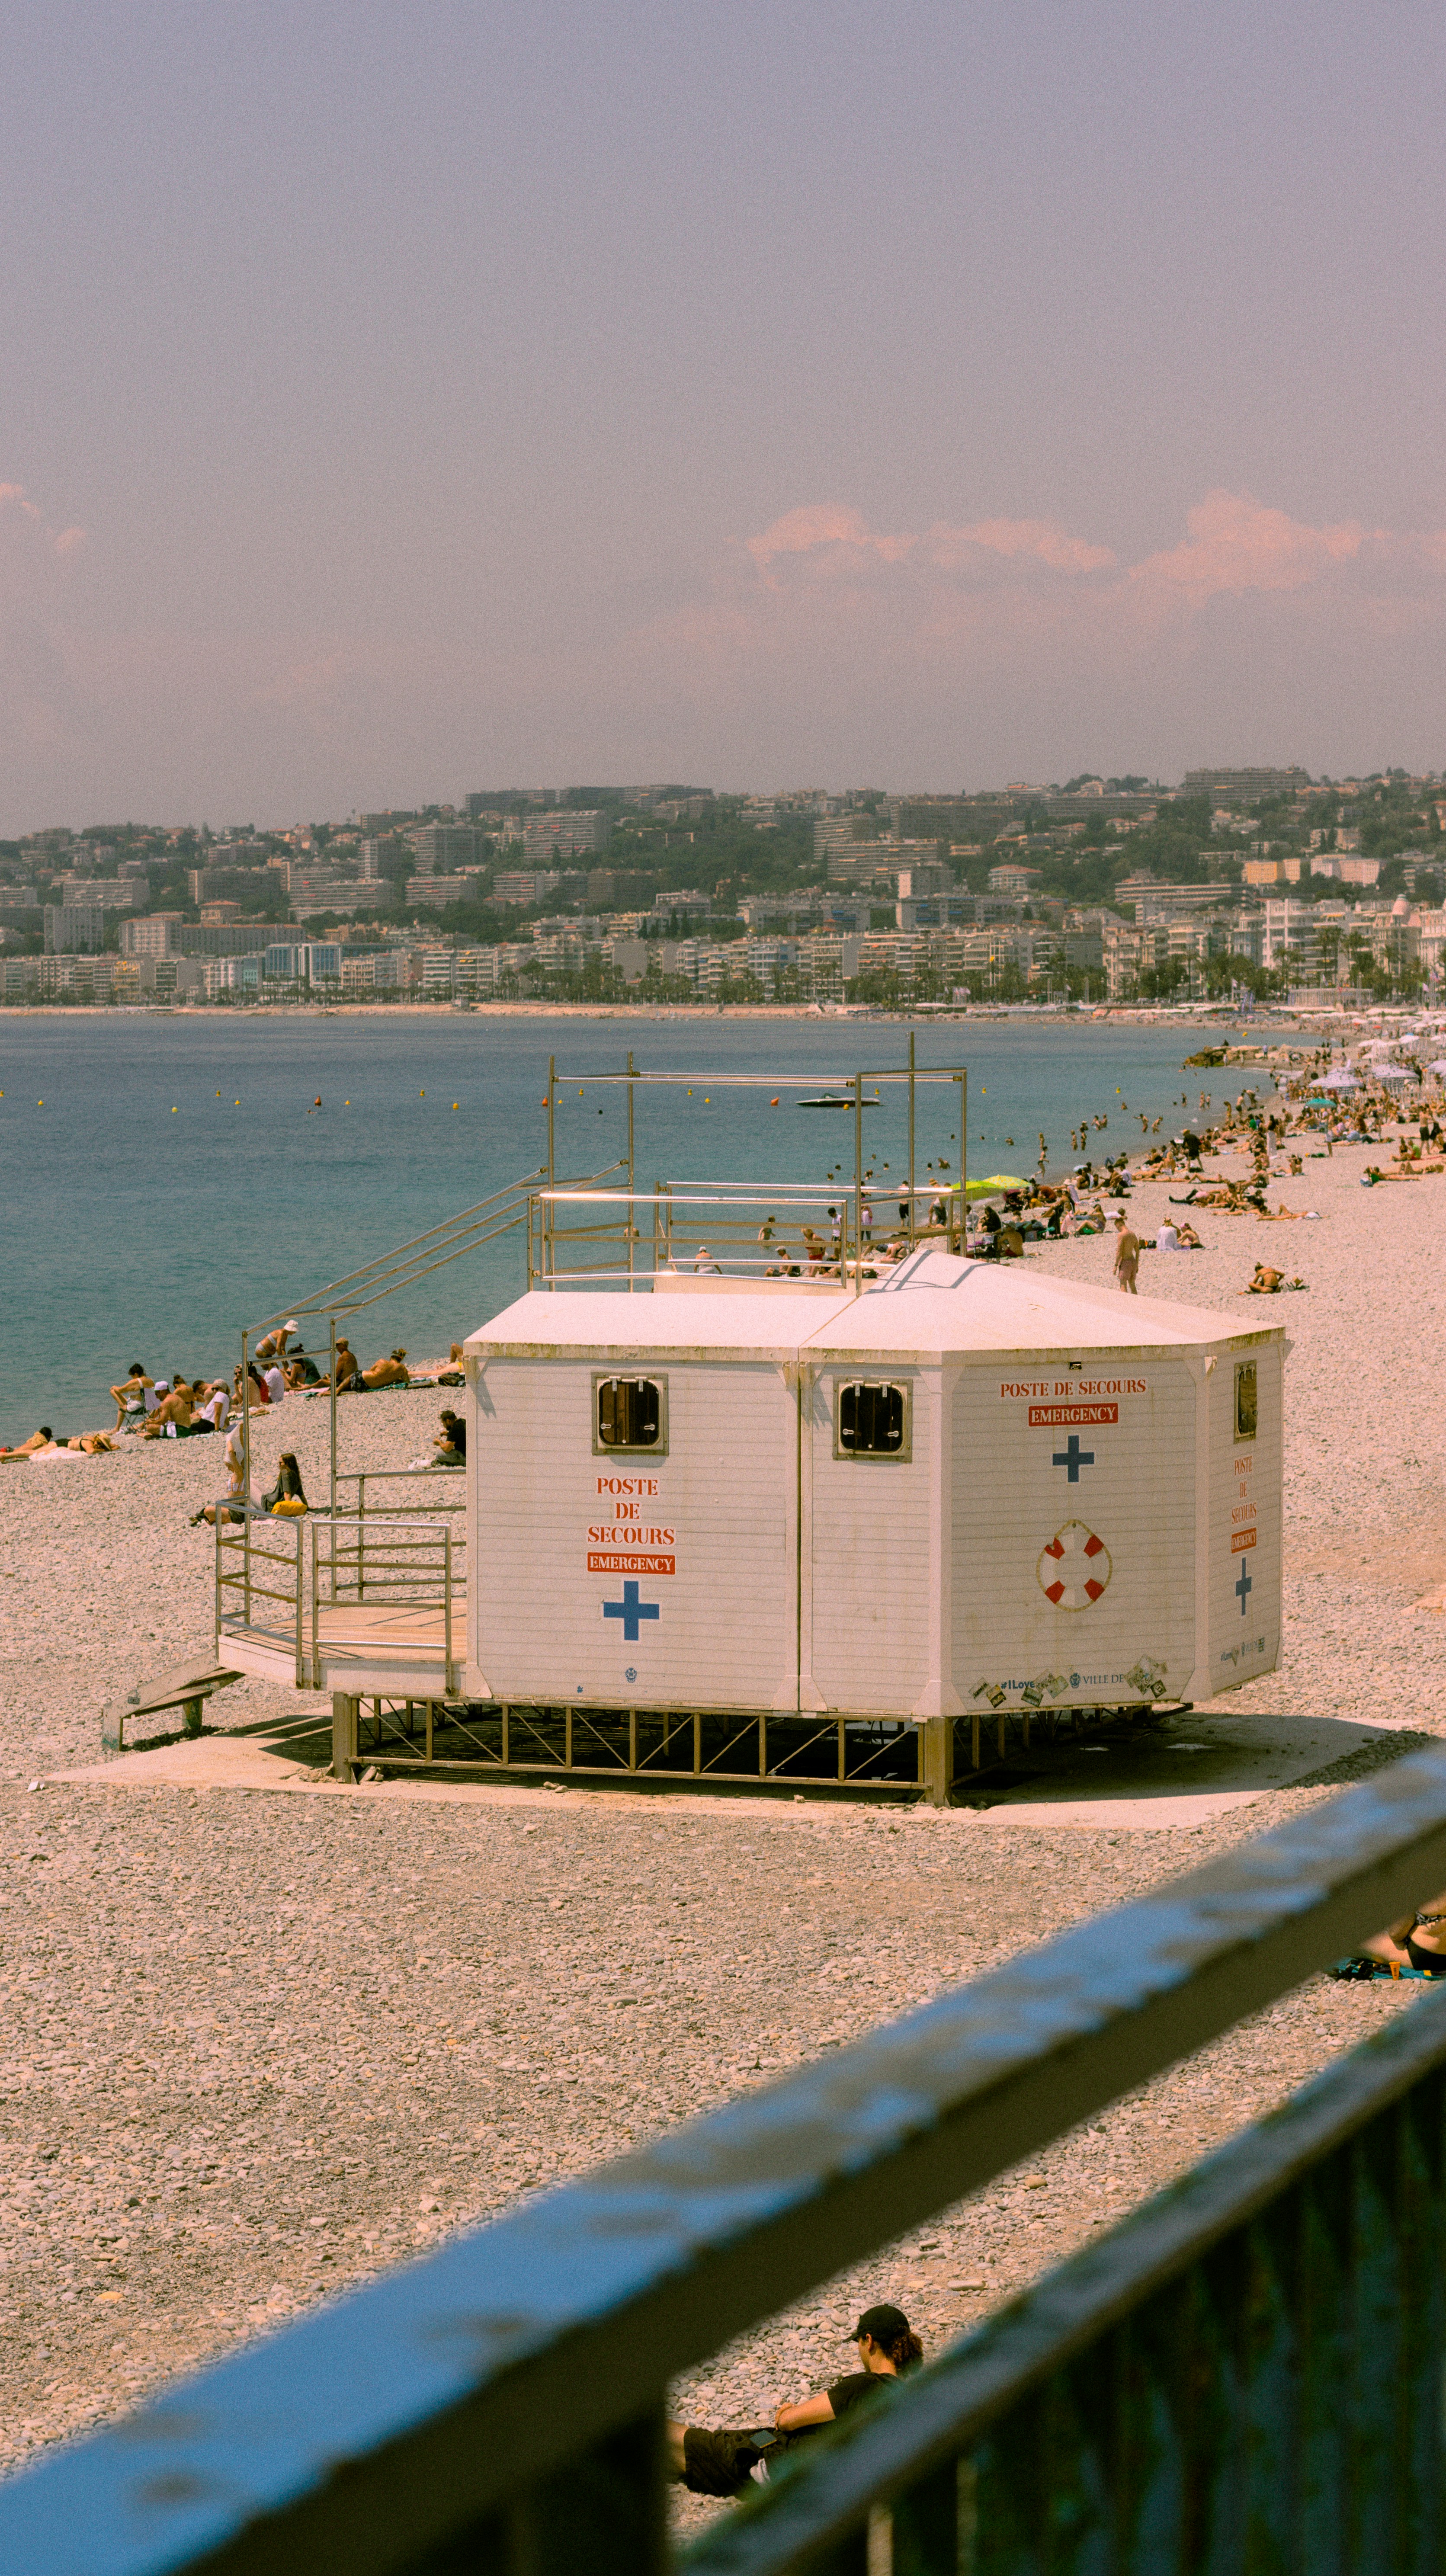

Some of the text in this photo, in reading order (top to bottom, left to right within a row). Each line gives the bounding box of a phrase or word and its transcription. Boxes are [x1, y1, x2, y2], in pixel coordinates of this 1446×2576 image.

[1000, 1379, 1146, 1397] POSTE DE SECOURS
[1031, 1407, 1116, 1423] EMERGENCY
[1234, 1456, 1253, 1476] POSTE
[597, 1478, 658, 1496] POSTE
[1240, 1481, 1247, 1499] DE
[615, 1503, 640, 1519] DE
[1231, 1502, 1257, 1525] SECOURS
[588, 1526, 675, 1545] SECOURS
[1232, 1531, 1257, 1550] EMERGENCY
[590, 1556, 673, 1571] EMERGENCY
[1082, 1674, 1125, 1684] VILLE DE
